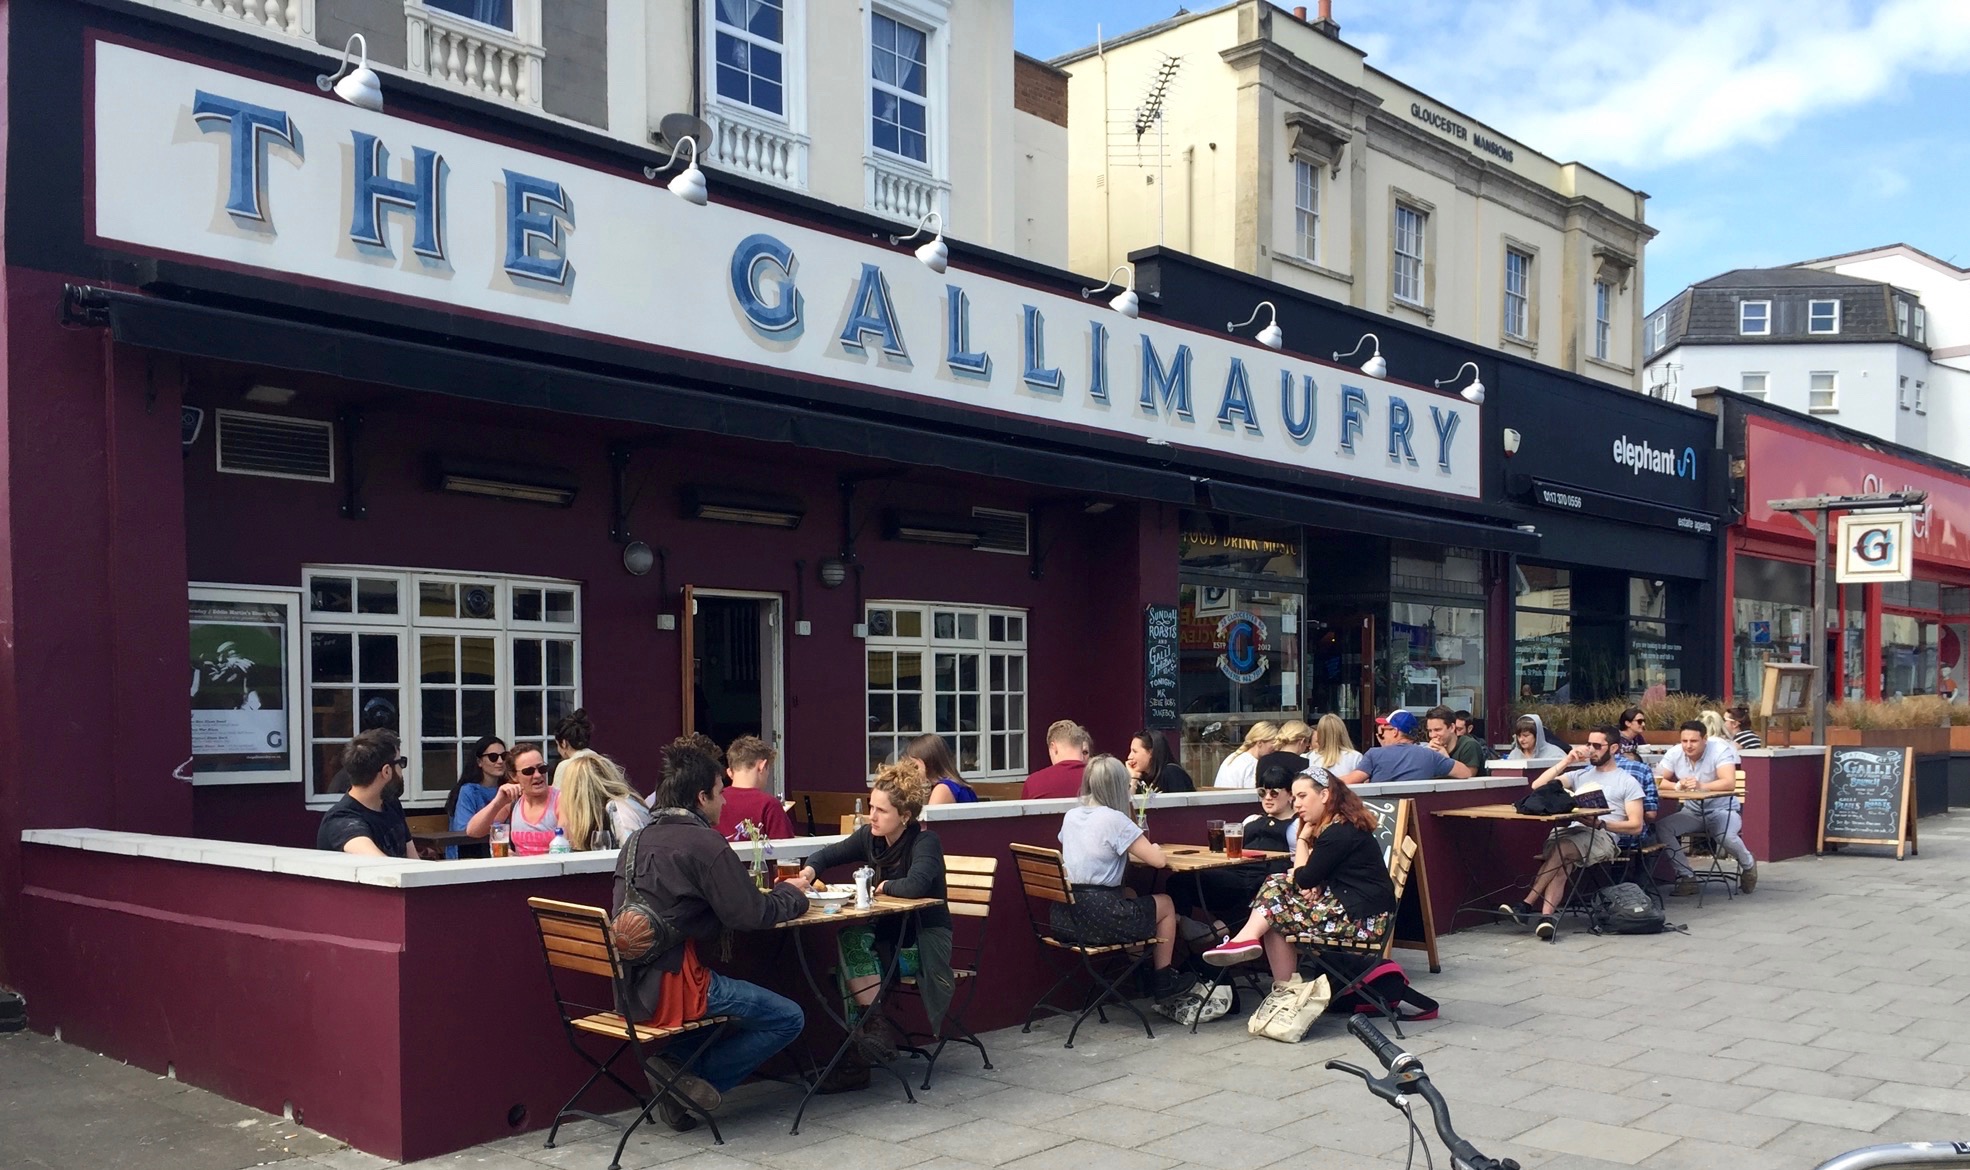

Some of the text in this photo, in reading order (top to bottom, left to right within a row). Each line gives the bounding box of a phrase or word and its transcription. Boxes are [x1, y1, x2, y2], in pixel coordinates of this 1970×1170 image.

[1411, 103, 1513, 162] GLOUCESTER MANSIONS
[194, 89, 1461, 470] THE GALLIMAUFRY
[1613, 435, 1675, 475] elephant
[1543, 490, 1557, 504] 0117
[1677, 517, 1712, 533] estate agents
[1223, 536, 1259, 551] DRINK
[1853, 528, 1894, 566] G
[1149, 607, 1178, 625] SUNDAY
[1149, 625, 1177, 639] ROASTS
[1228, 623, 1255, 672] G
[1258, 643, 1271, 651] 2012
[1150, 679, 1176, 688] TONIGHT
[1152, 708, 1176, 719] JUKEBOX
[266, 730, 283, 749] G
[1843, 761, 1892, 775] GALLI
